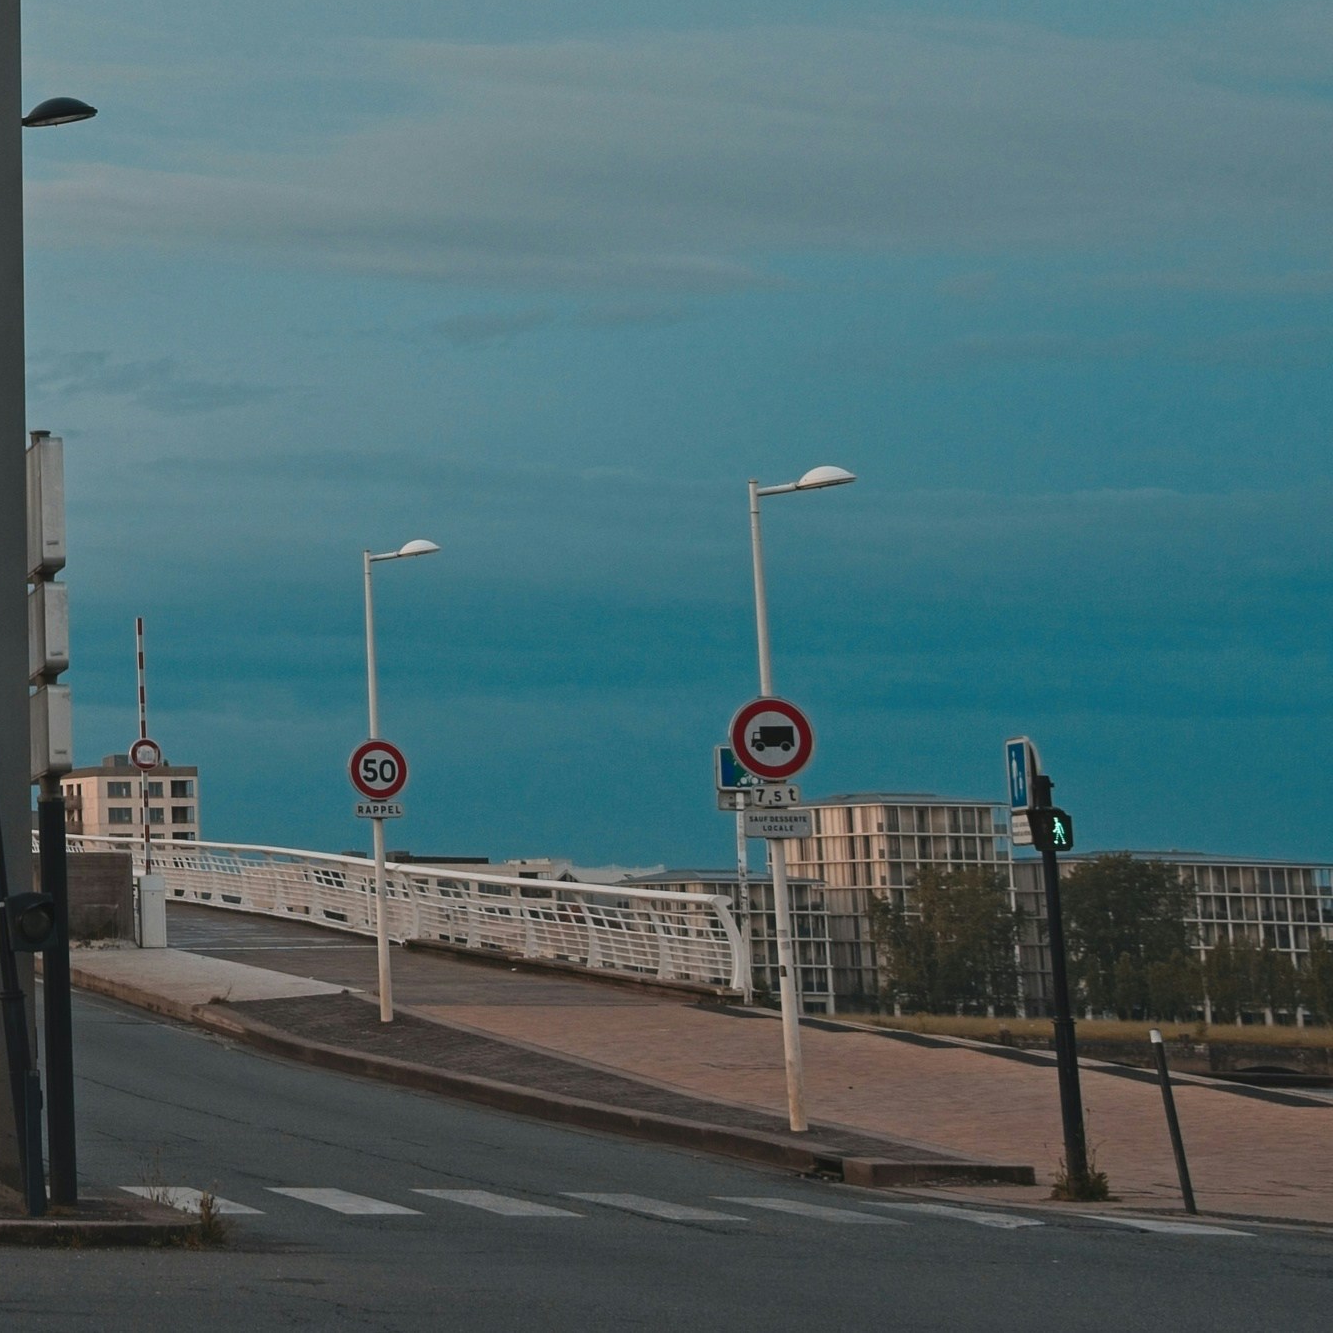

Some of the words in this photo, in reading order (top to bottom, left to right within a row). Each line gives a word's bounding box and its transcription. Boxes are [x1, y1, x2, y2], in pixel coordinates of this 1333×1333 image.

[362, 758, 396, 783] 50
[755, 789, 782, 805] 7,5
[788, 788, 796, 801] t
[357, 805, 401, 814] RAPPEL
